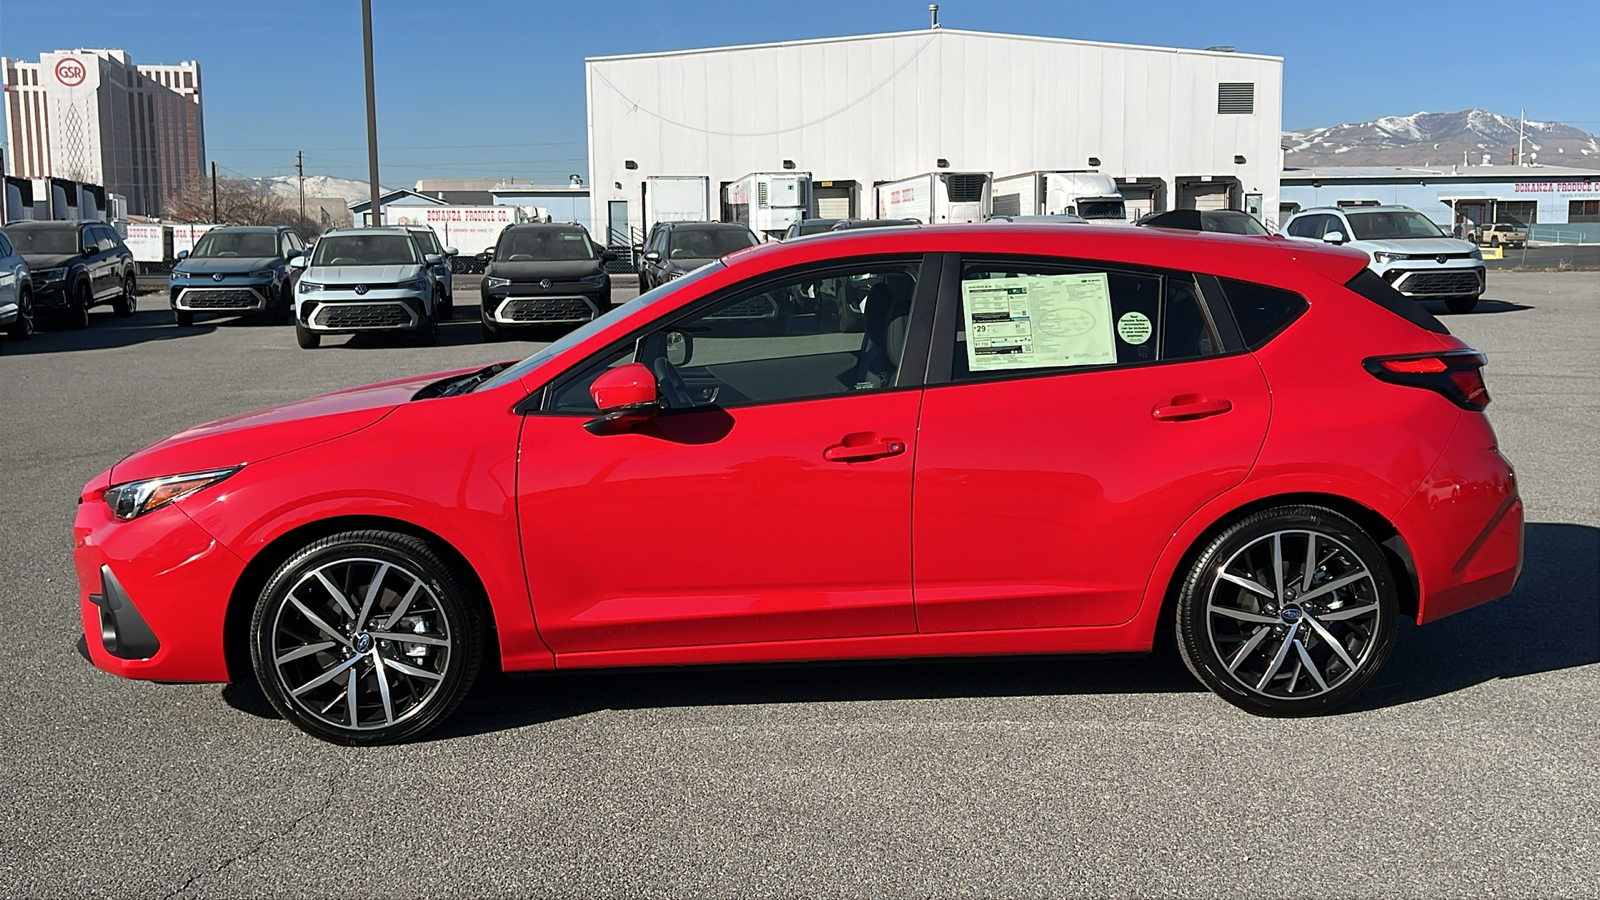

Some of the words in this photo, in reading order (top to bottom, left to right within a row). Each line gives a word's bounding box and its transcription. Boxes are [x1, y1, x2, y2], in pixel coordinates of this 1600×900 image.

[59, 66, 81, 78] GSR
[1515, 183, 1554, 192] BONANZA
[1557, 182, 1592, 192] PRODUCE
[427, 210, 461, 221] BONANZA
[465, 210, 495, 221] PRODUCE
[498, 210, 509, 221] CO.
